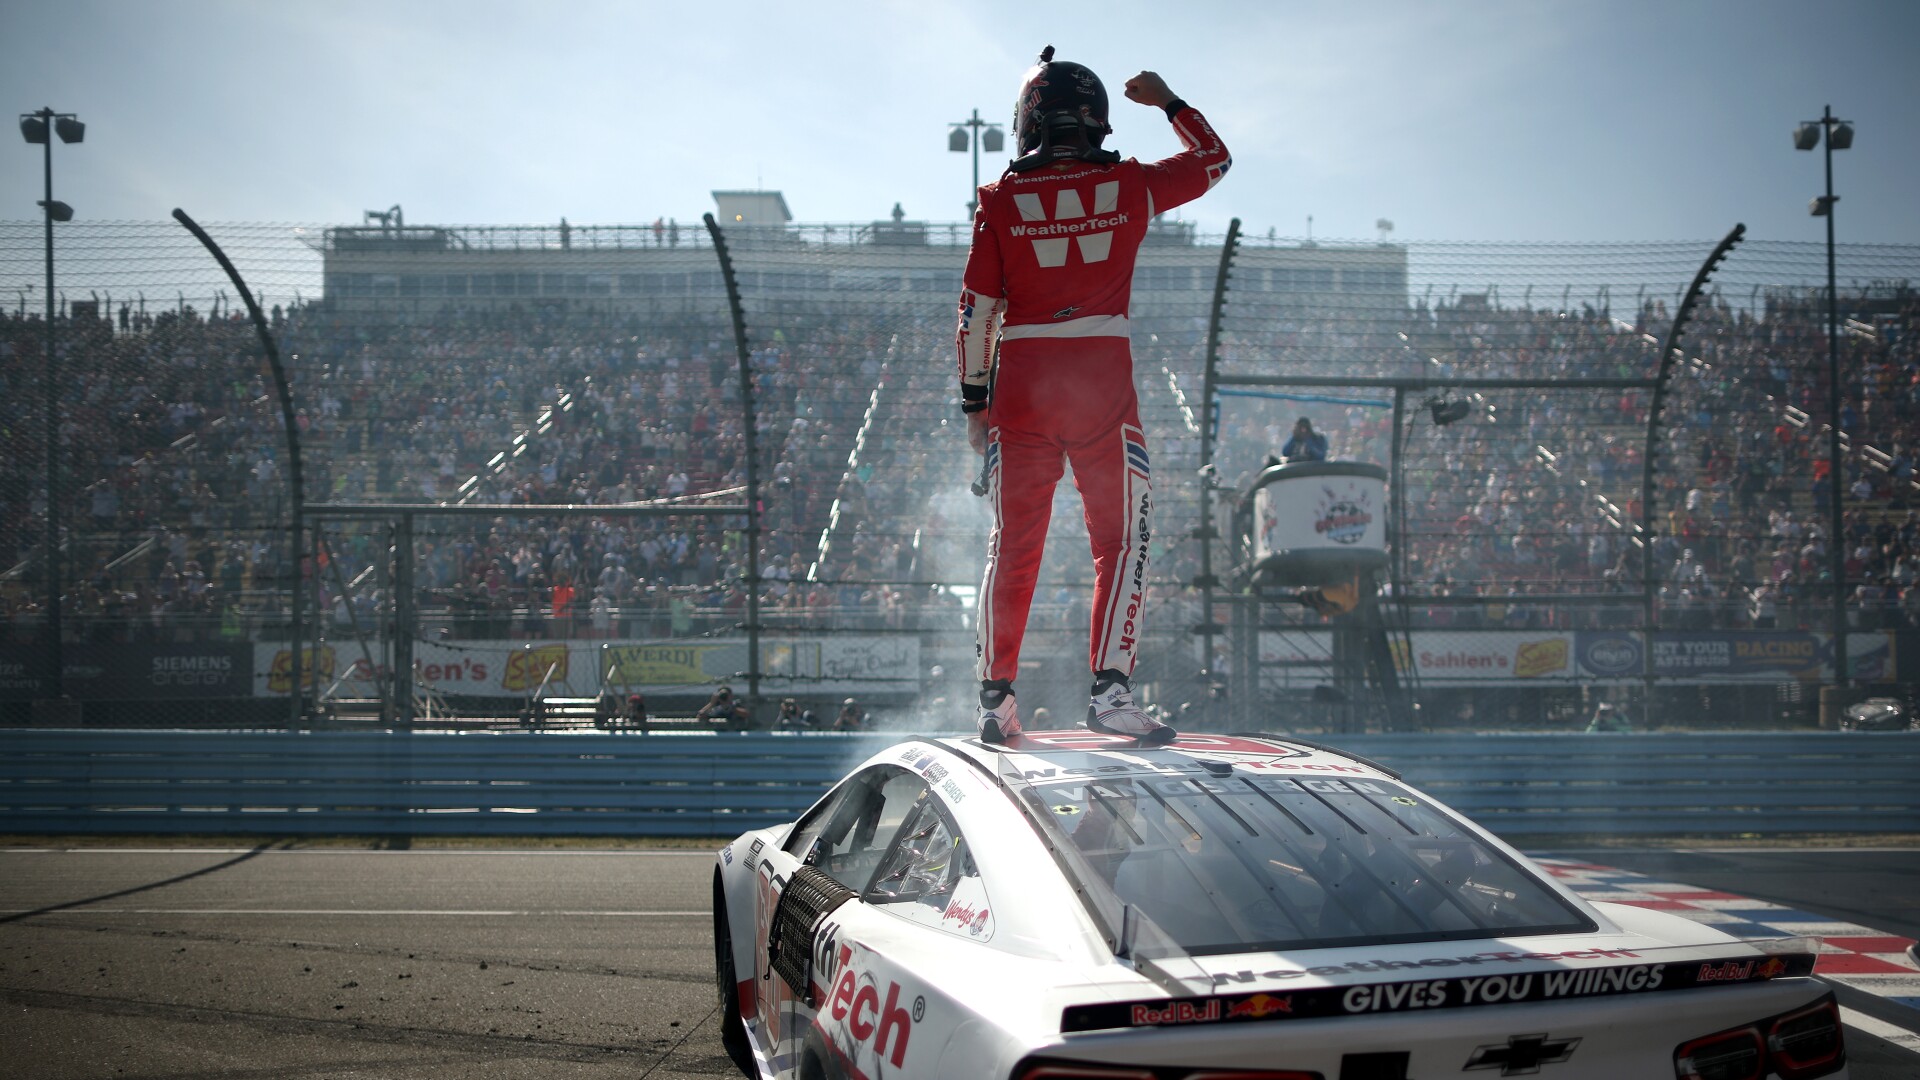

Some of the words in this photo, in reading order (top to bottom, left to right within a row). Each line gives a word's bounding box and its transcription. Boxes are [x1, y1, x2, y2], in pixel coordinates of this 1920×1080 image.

[1010, 213, 1129, 237] WeatherTech
[1682, 640, 1730, 655] YOUR
[1735, 639, 1814, 656] RACING
[152, 656, 232, 670] SIEMENS
[1420, 651, 1508, 669] Sahlen's
[1654, 655, 1692, 667] ASTE
[941, 779, 966, 804] SIEMENS
[942, 899, 976, 929] Wendy's
[1342, 980, 1448, 1013] GIVES
[1460, 974, 1532, 1004] YOU
[1543, 964, 1666, 998] WIIINGS
[1131, 1002, 1176, 1025] Red
[1177, 999, 1221, 1022] Bull
